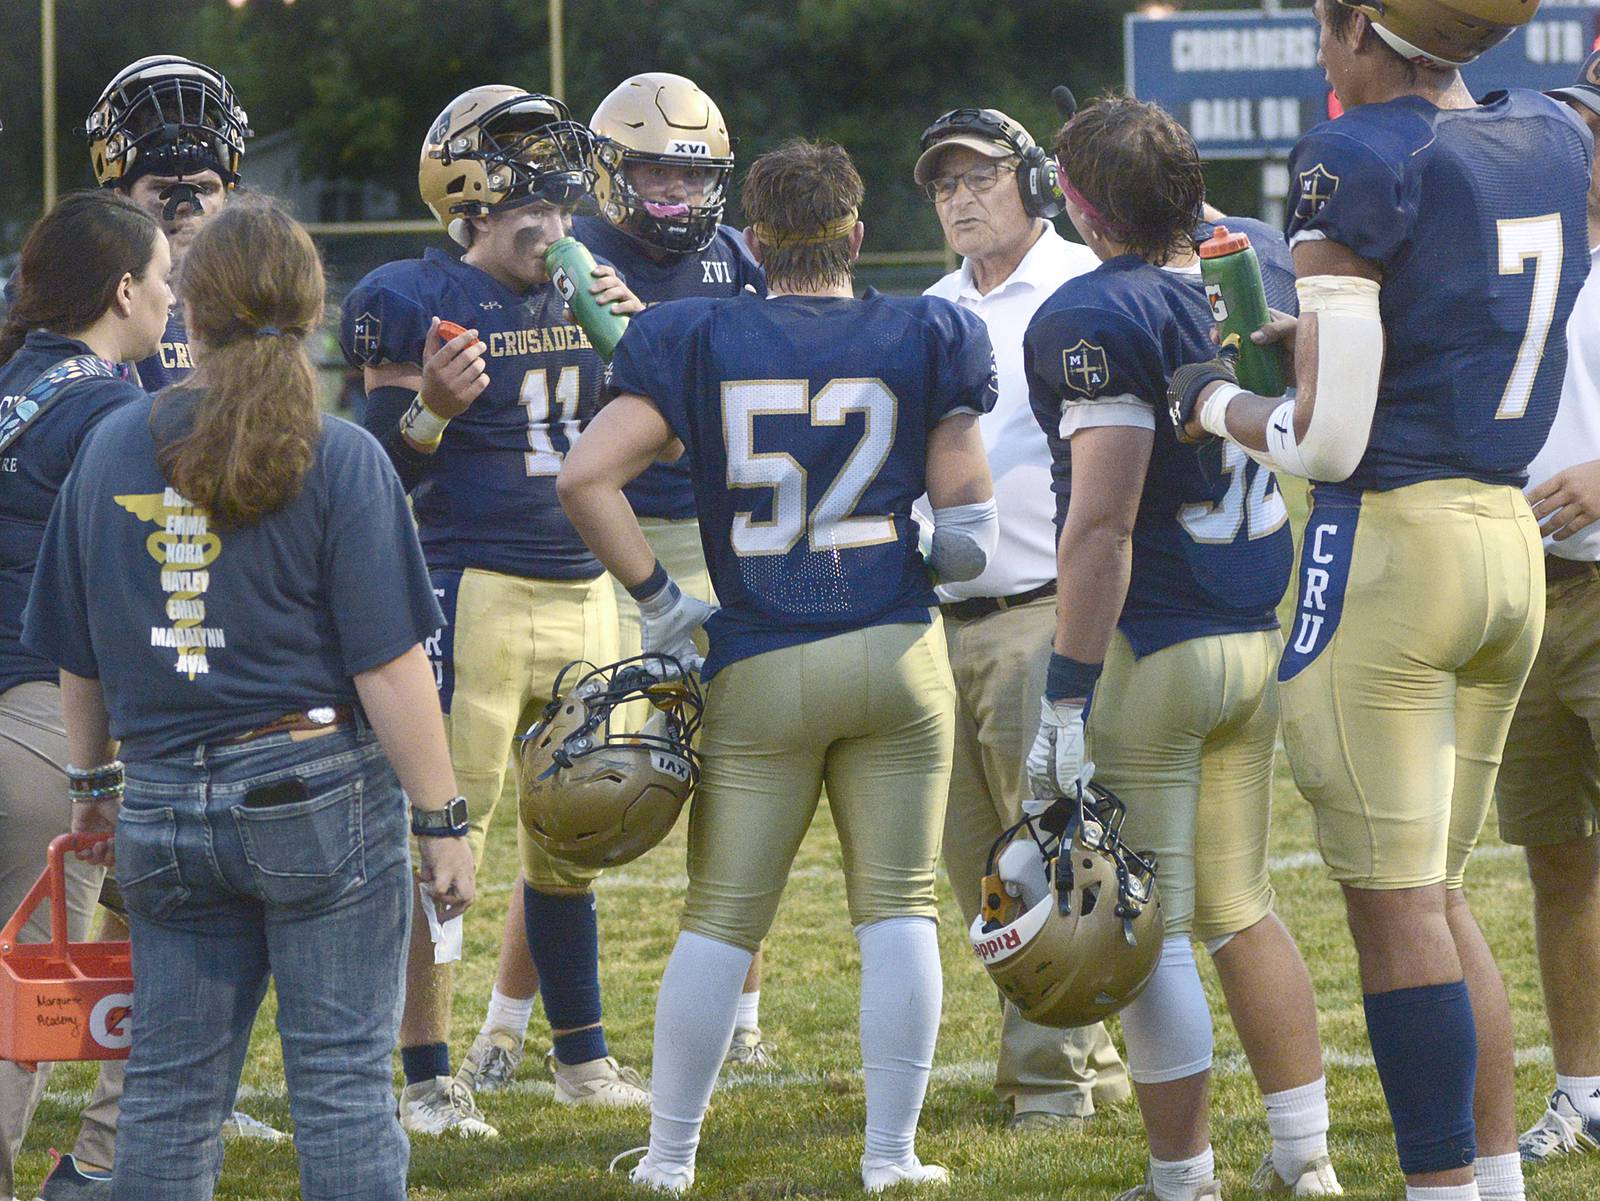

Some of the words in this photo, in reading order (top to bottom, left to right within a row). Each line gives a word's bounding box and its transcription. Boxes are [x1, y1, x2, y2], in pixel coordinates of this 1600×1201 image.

[673, 143, 706, 154] XVI
[701, 261, 732, 283] XVI
[1495, 212, 1563, 419] 7
[1069, 356, 1081, 366] M
[1091, 373, 1101, 384] A
[518, 365, 581, 477] 11
[720, 378, 898, 557] 52
[166, 543, 203, 563] NORA
[1294, 524, 1338, 654] CRU
[176, 655, 209, 673] AVA
[659, 756, 687, 777] XVI
[89, 993, 134, 1050] G
